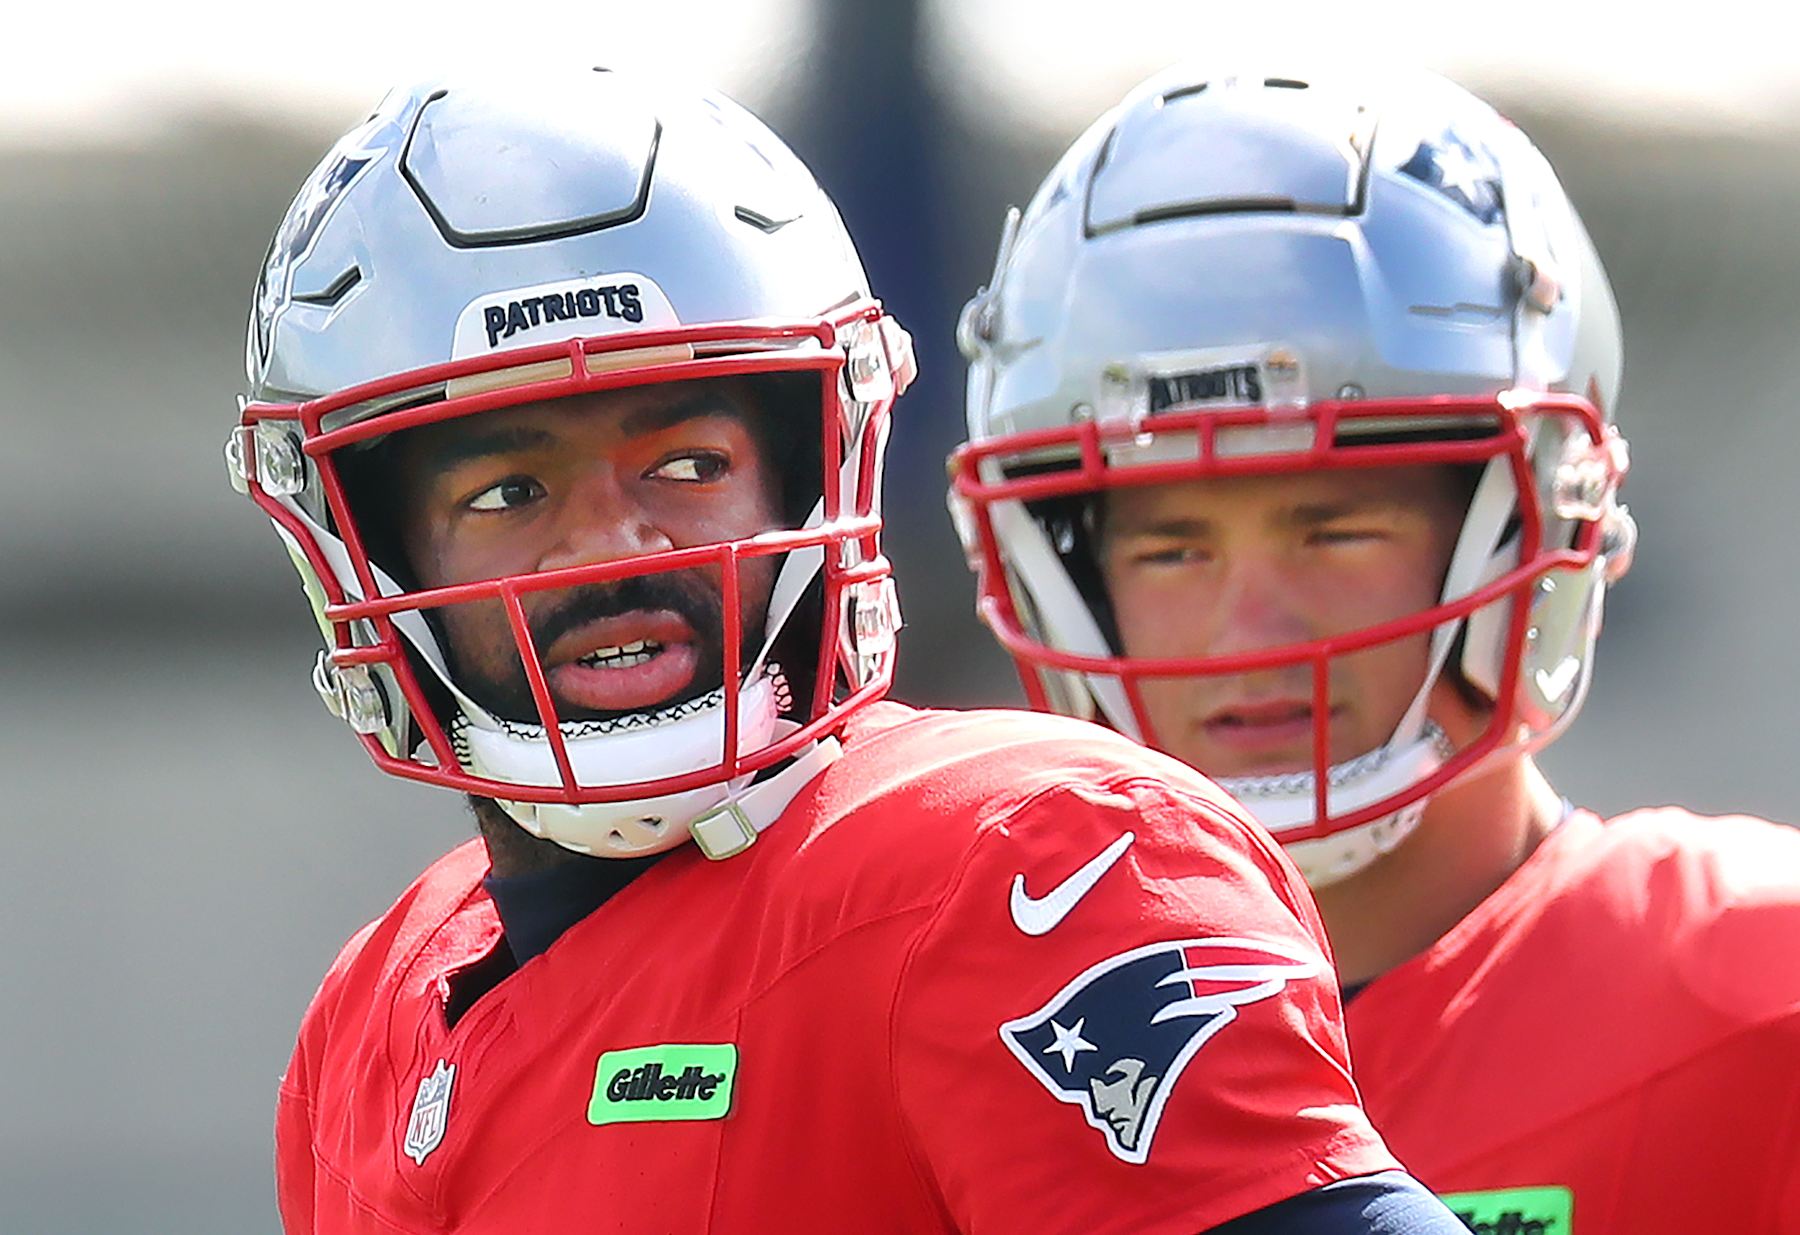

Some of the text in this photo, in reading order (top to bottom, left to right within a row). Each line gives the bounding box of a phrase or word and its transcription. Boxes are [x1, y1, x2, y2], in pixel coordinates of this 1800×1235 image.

[484, 284, 643, 347] PATRIOTS
[607, 1063, 717, 1102] Gillette
[411, 1105, 438, 1145] NFL
